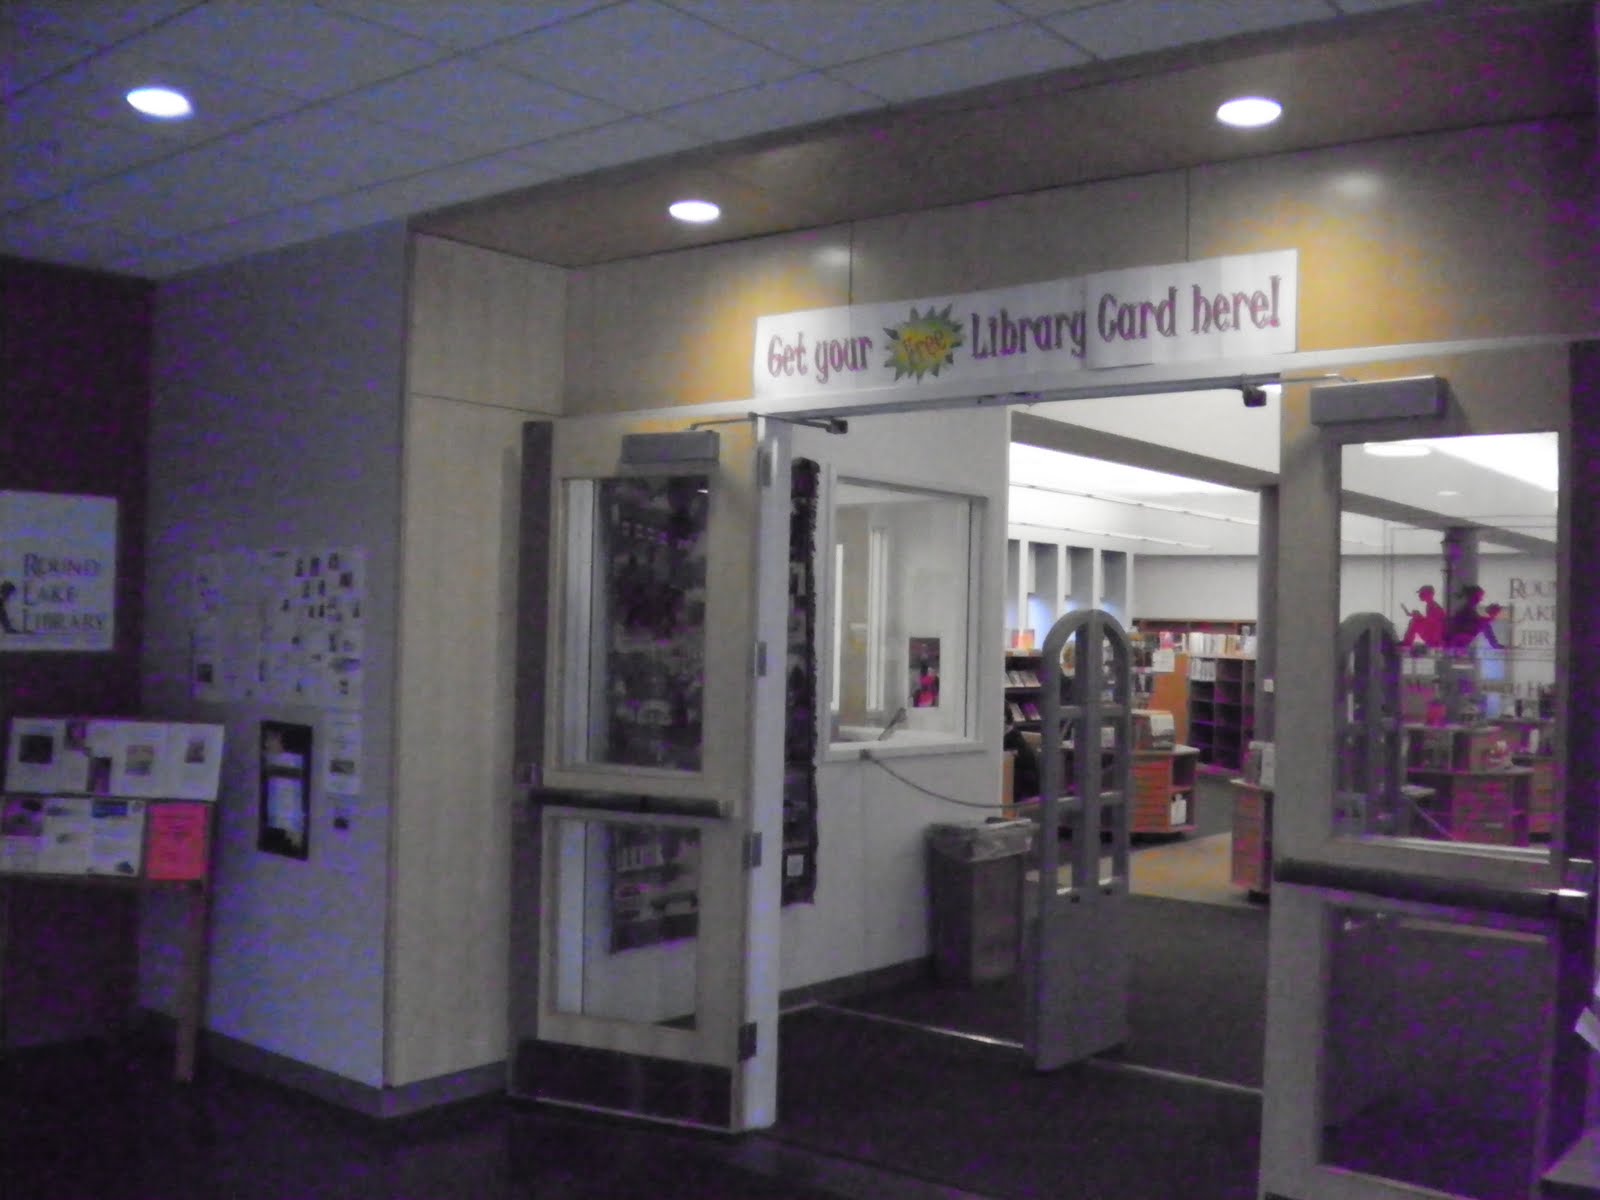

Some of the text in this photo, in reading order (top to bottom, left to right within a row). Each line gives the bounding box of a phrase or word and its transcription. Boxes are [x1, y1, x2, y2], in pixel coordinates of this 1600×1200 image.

[767, 331, 808, 378] Get
[814, 335, 873, 385] your
[971, 307, 1087, 360] Library
[1097, 286, 1178, 343] Card
[1191, 275, 1282, 334] here!
[23, 552, 102, 578] ROUND
[22, 579, 79, 606] LAKE
[1509, 577, 1557, 600] ROU
